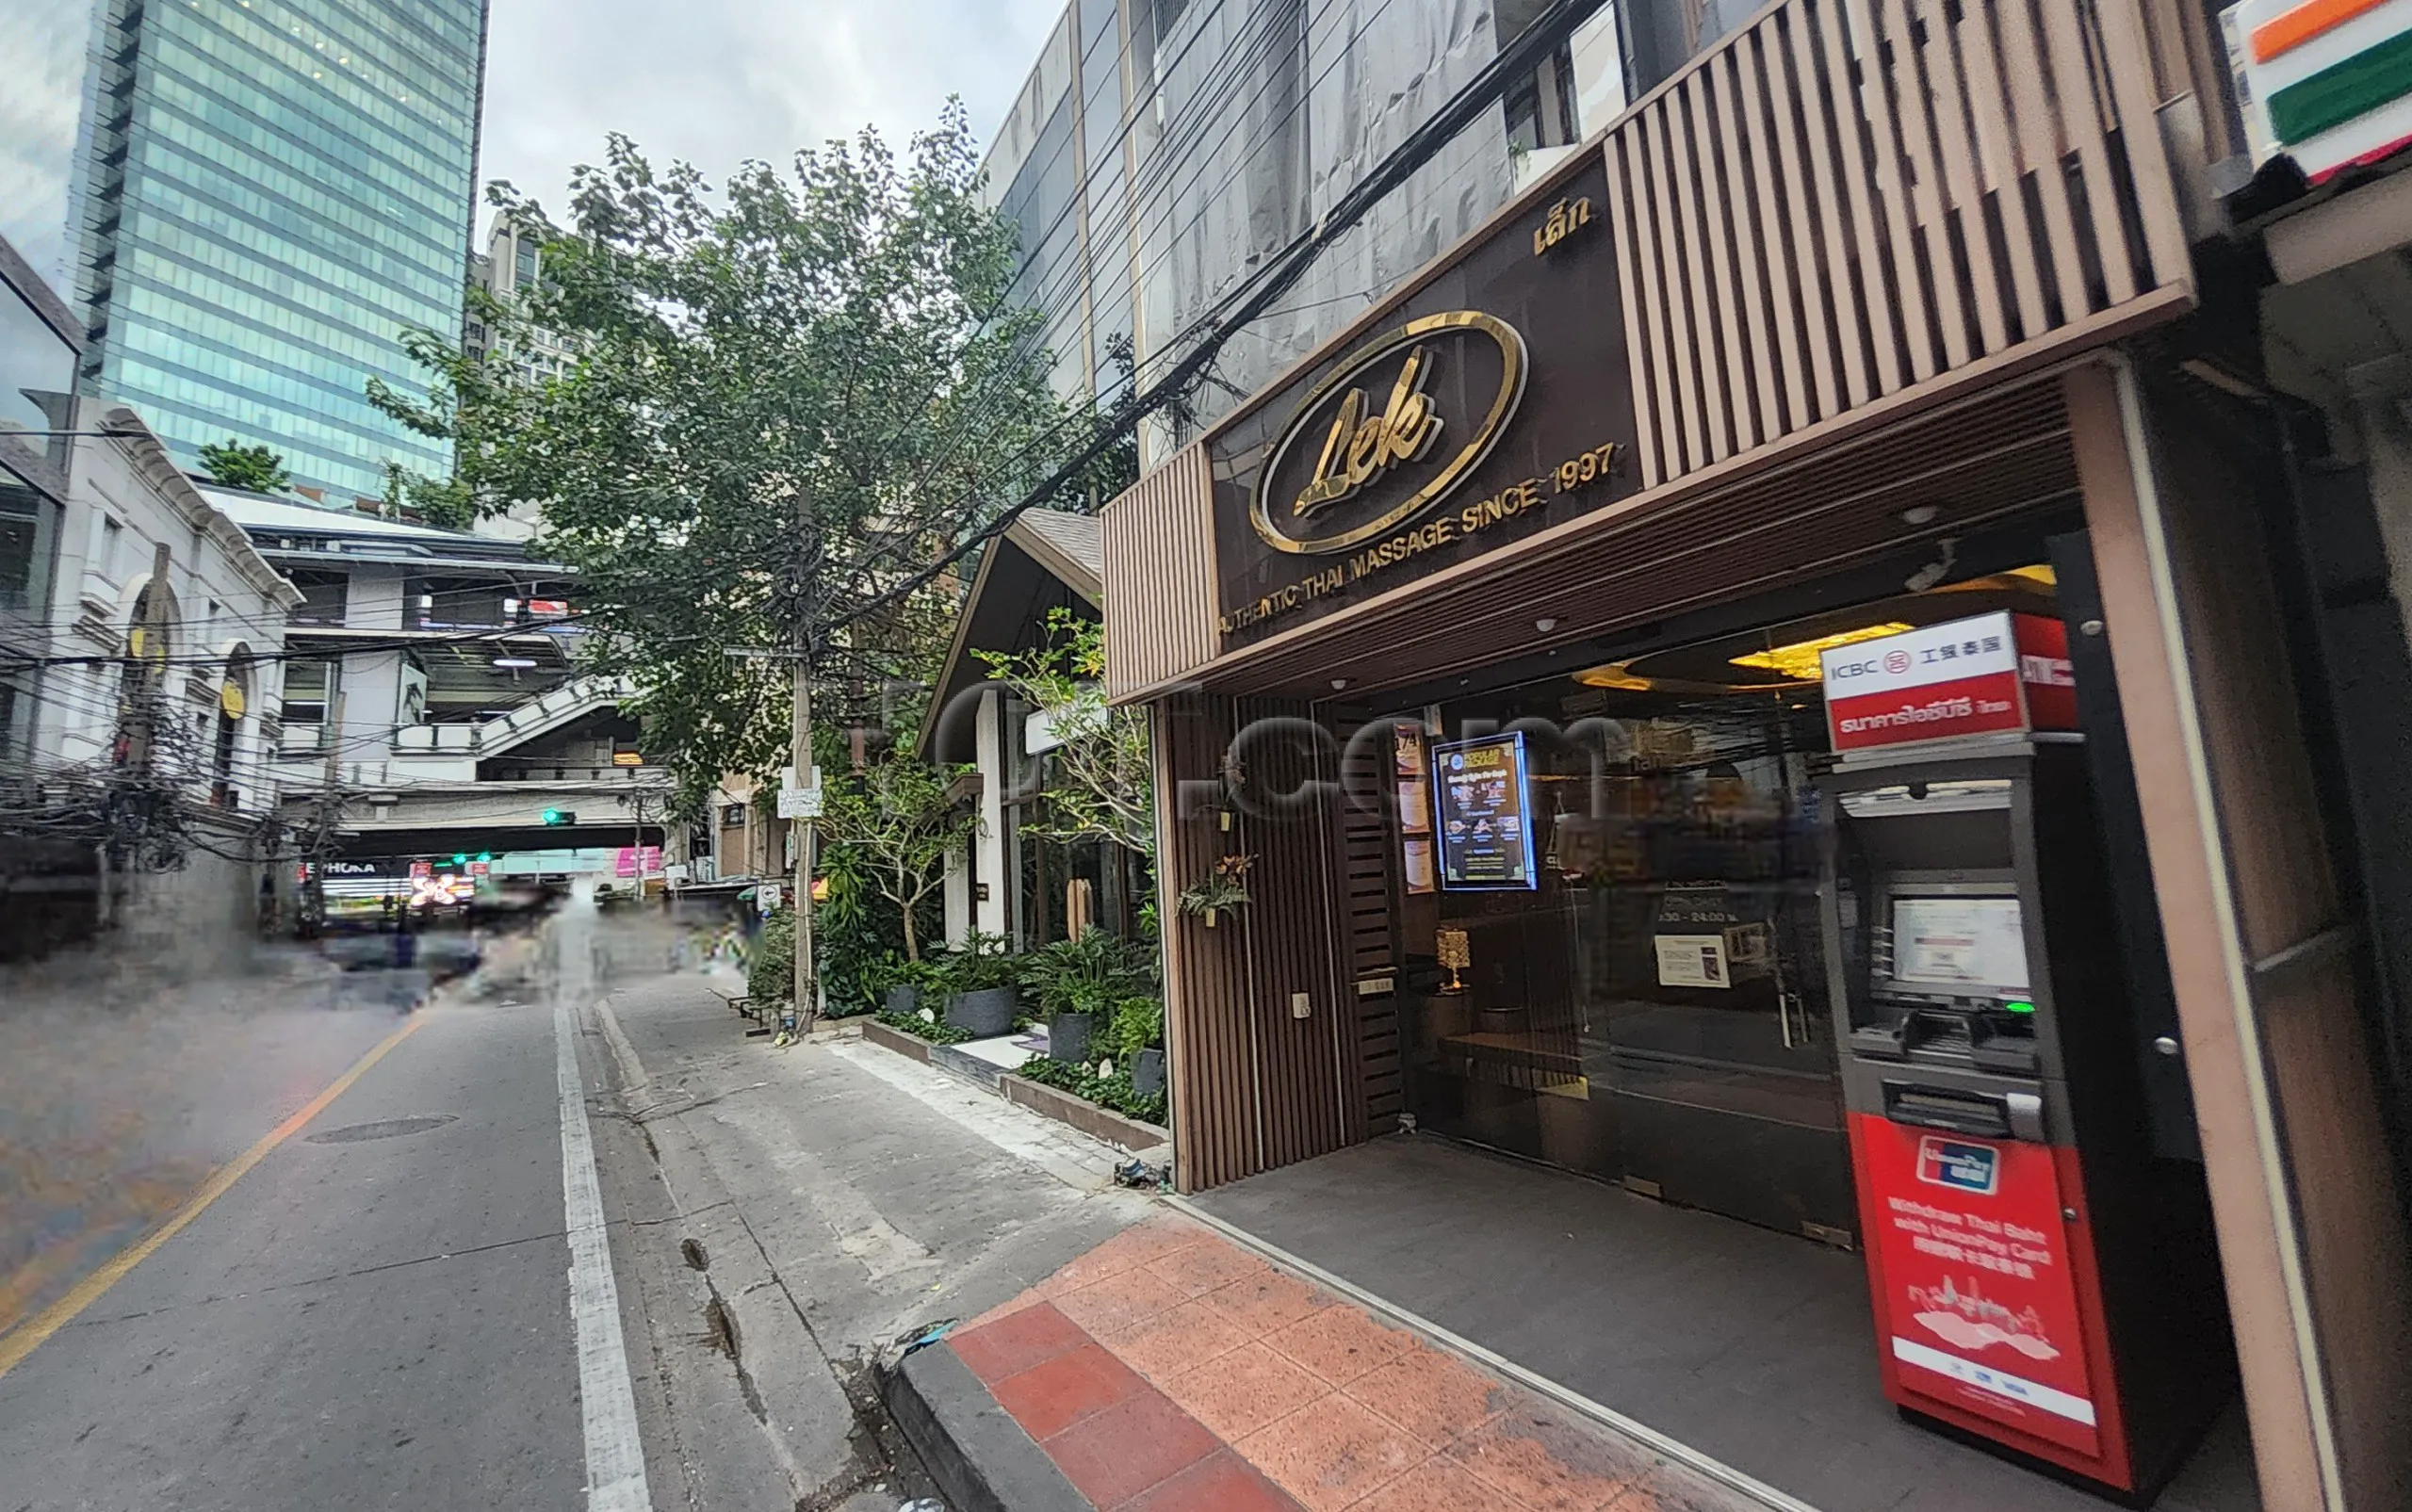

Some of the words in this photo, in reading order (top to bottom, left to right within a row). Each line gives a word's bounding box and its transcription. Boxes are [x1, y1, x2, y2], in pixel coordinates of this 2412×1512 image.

[1292, 345, 1439, 518] Lek
[1301, 564, 1344, 601] THAI
[1349, 515, 1454, 583] MASSAGE
[1460, 478, 1540, 534] SINCE
[1548, 442, 1616, 495] 1997
[1831, 660, 1880, 680] ICBC
[2009, 1243, 2053, 1266] Card
